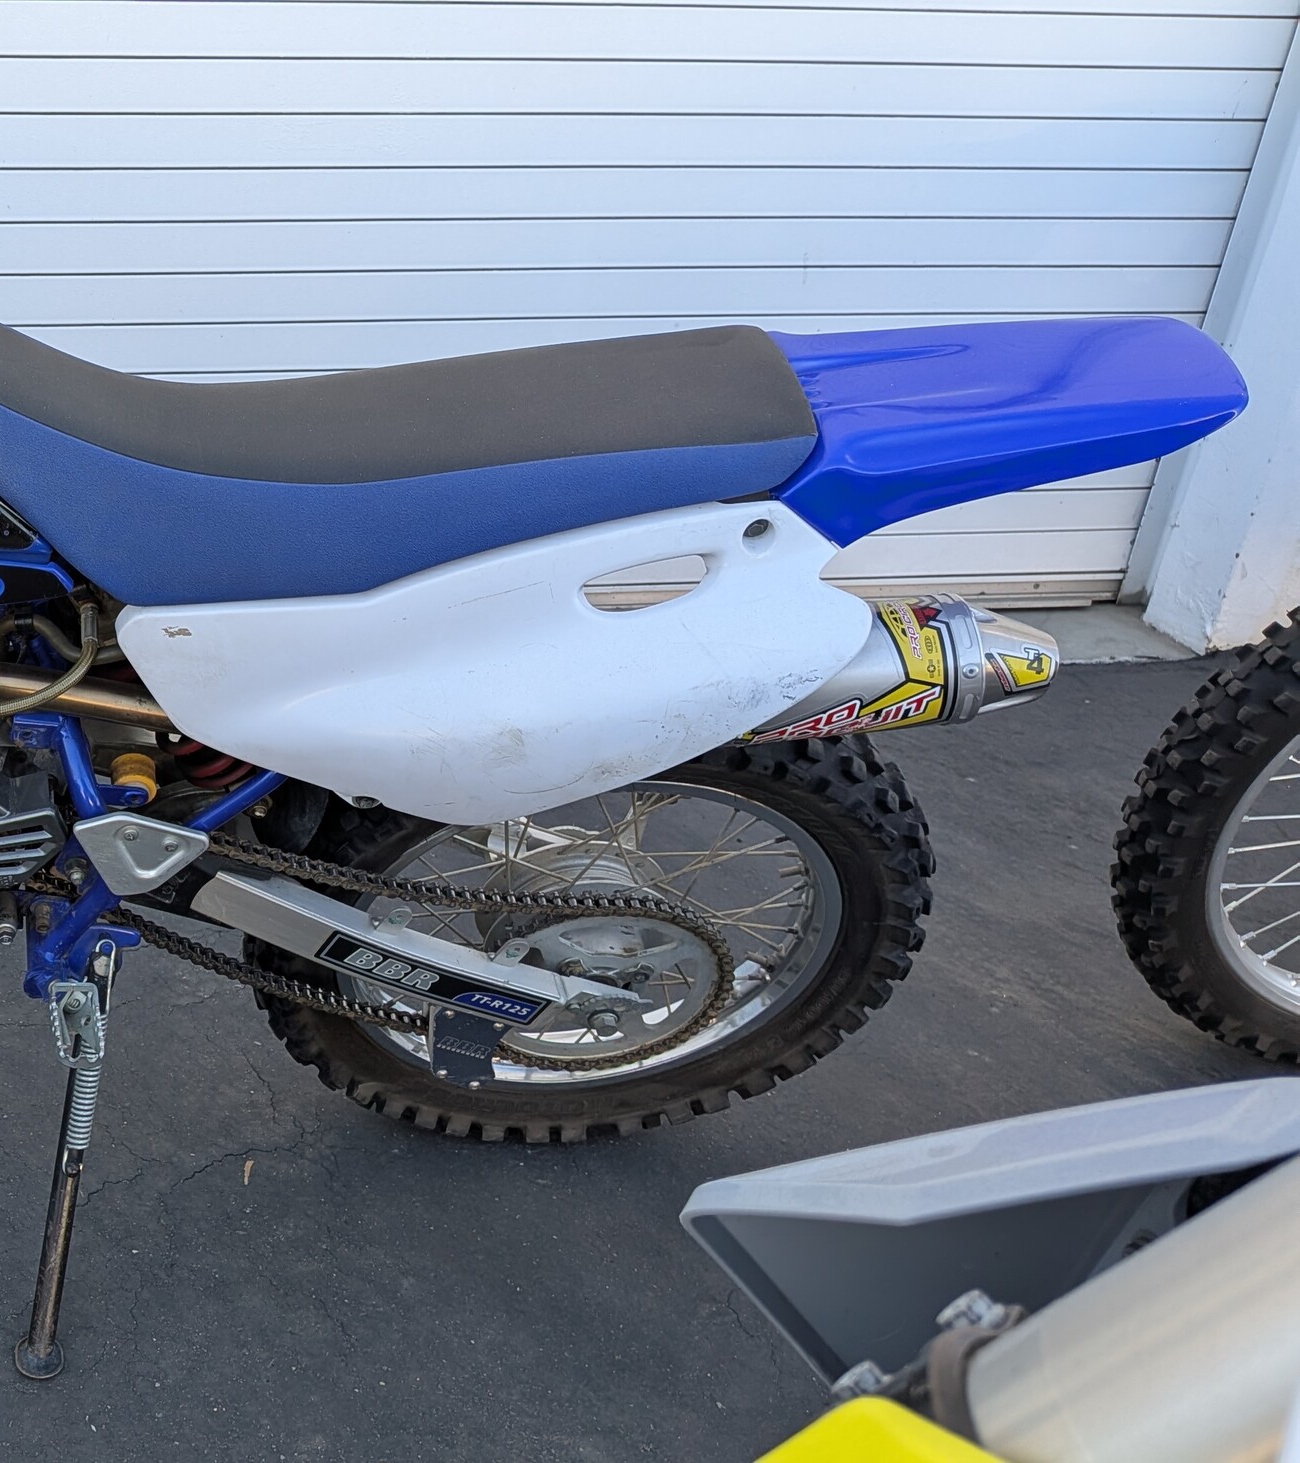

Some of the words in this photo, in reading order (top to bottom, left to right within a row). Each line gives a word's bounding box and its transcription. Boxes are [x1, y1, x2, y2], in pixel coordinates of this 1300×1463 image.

[750, 699, 862, 745] PRO
[343, 947, 441, 992] BBR
[469, 993, 532, 1017] TT-R125
[436, 1036, 492, 1059] BBR
